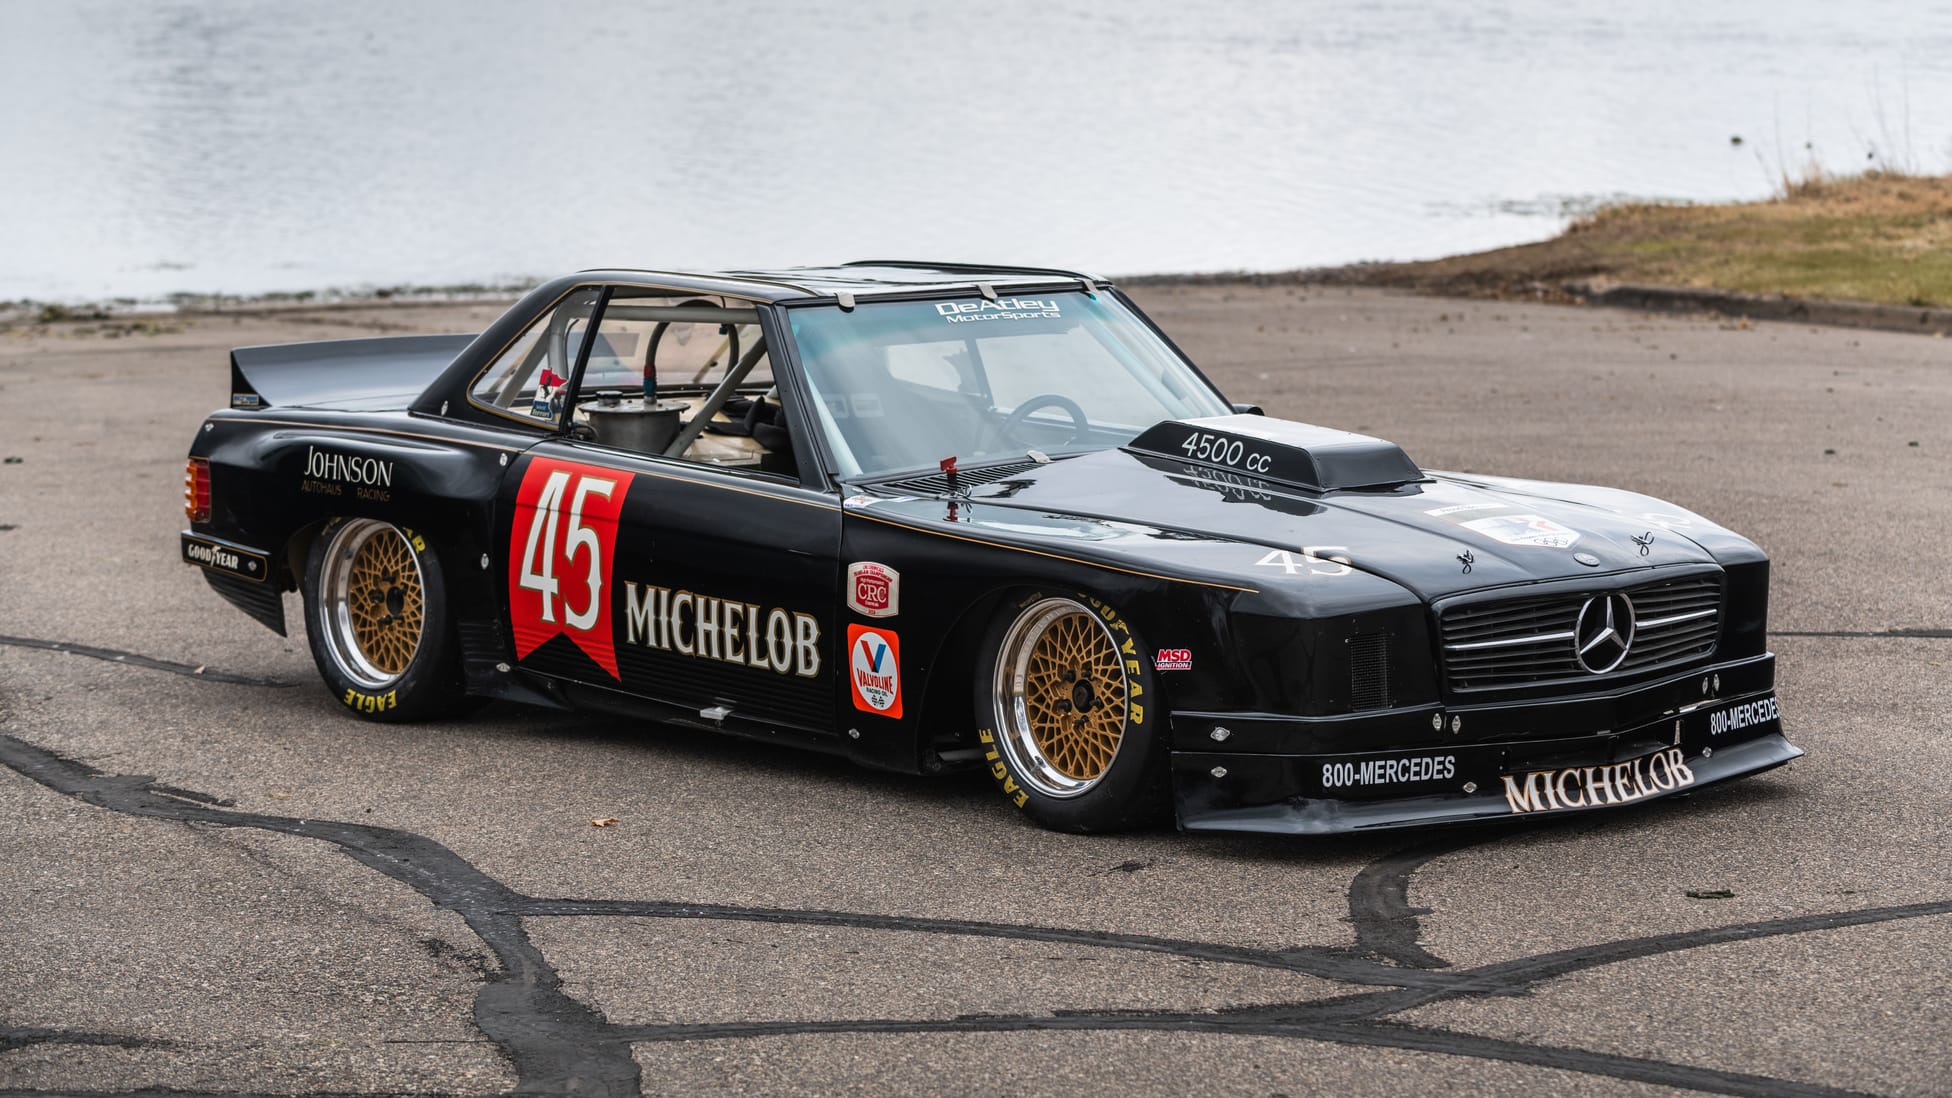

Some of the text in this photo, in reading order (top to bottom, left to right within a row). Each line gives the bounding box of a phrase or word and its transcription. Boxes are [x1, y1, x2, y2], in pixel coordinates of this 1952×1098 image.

[934, 298, 1060, 316] DeAtley
[945, 310, 1061, 324] MotorSports
[1182, 432, 1244, 466] 4500
[357, 487, 391, 503] RACING
[518, 470, 617, 632] 45
[1254, 546, 1354, 578] 45
[857, 582, 887, 603] CRC
[623, 580, 823, 679] MICHELOB
[1158, 649, 1192, 662] MSD
[856, 667, 894, 695] VALVOLINE
[343, 688, 397, 713] EAGLE
[979, 728, 1030, 809] EAGLE
[1322, 755, 1456, 788] 800-MERCEDES
[1500, 747, 1695, 814] MICHELOB
